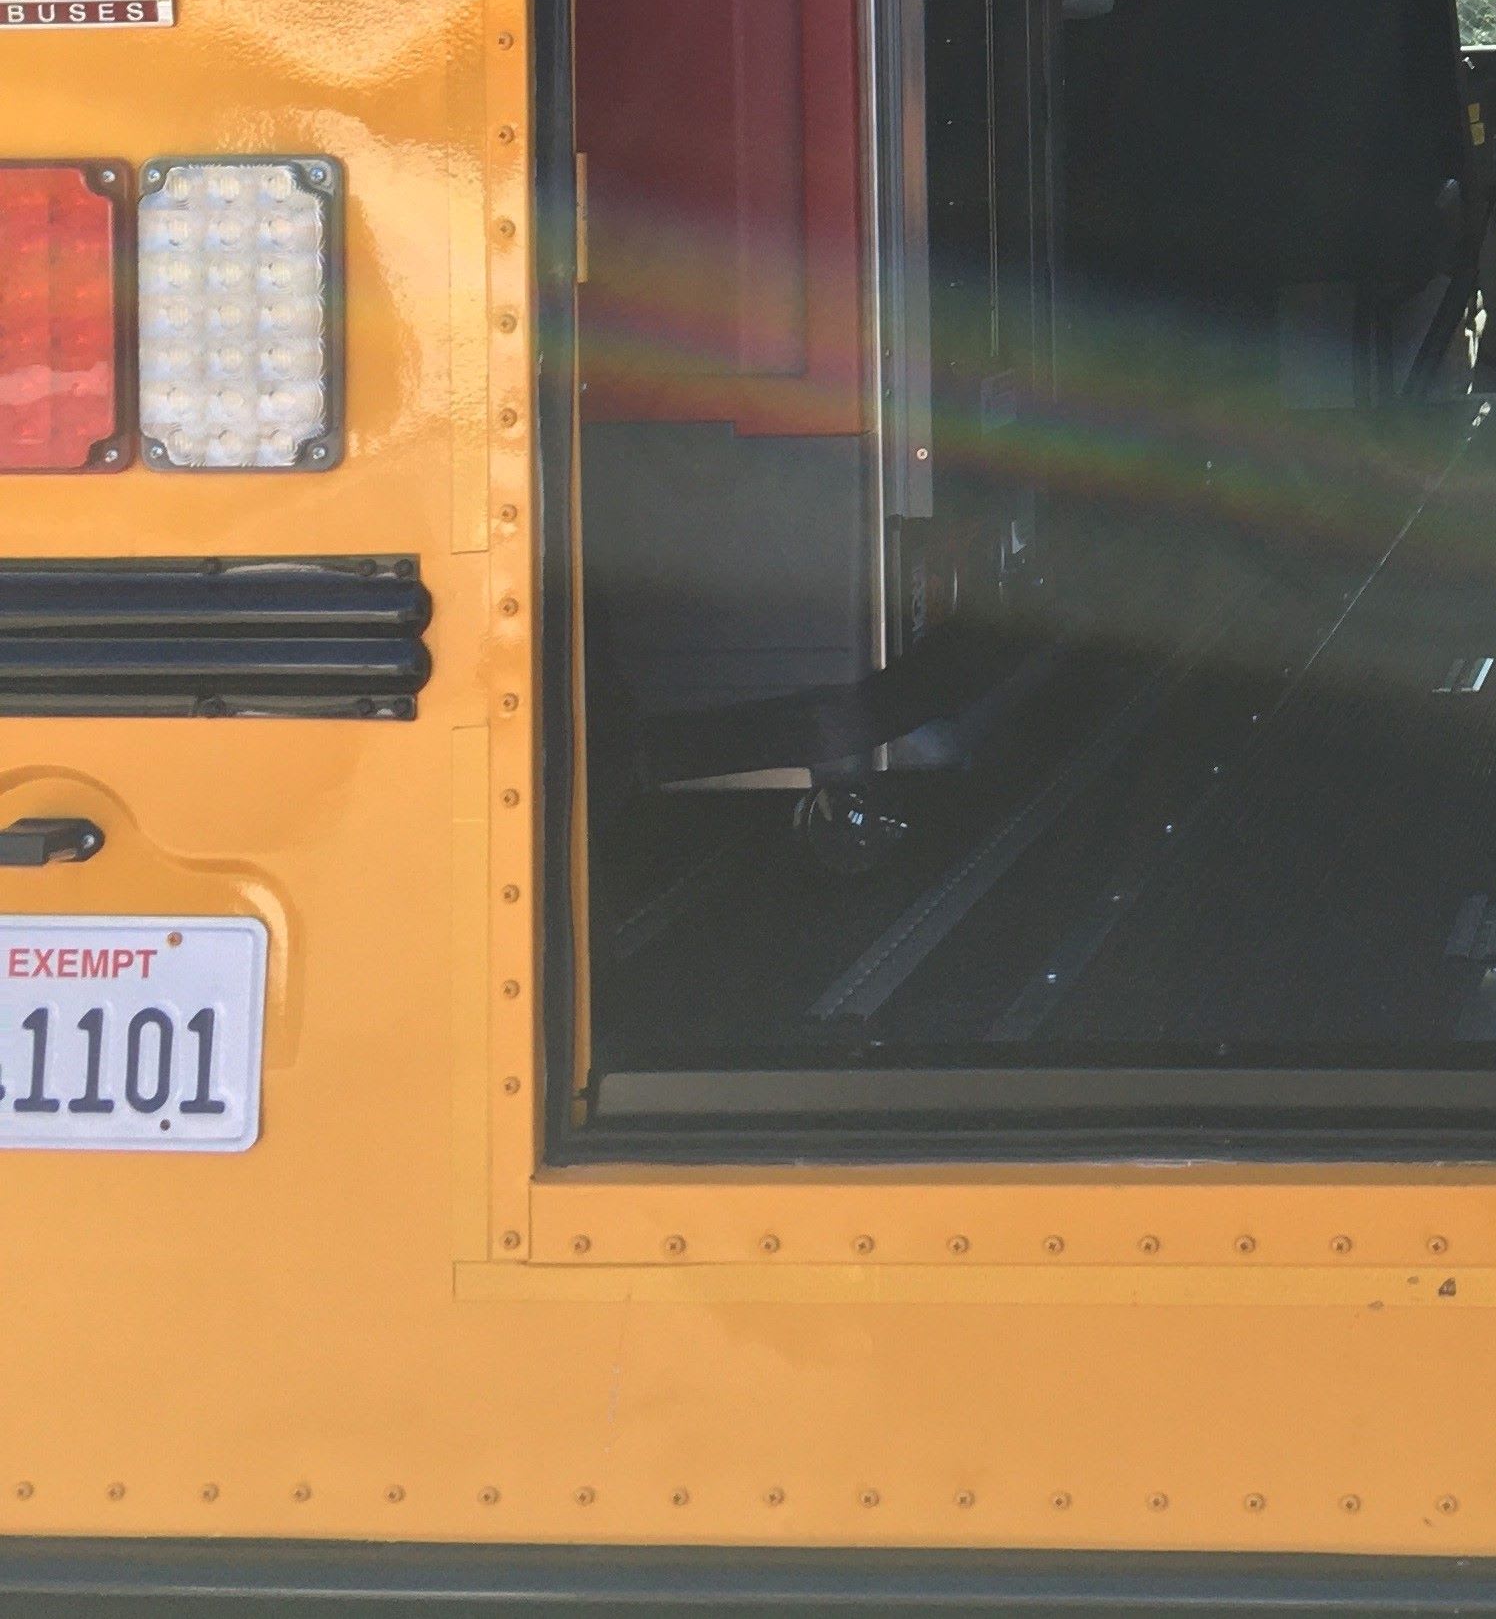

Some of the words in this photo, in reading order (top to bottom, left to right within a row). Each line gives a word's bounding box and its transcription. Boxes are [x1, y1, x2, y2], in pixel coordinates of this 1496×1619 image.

[7, 2, 145, 24] BUSES
[8, 947, 159, 978] EXEMPT
[0, 1006, 226, 1116] 1101
